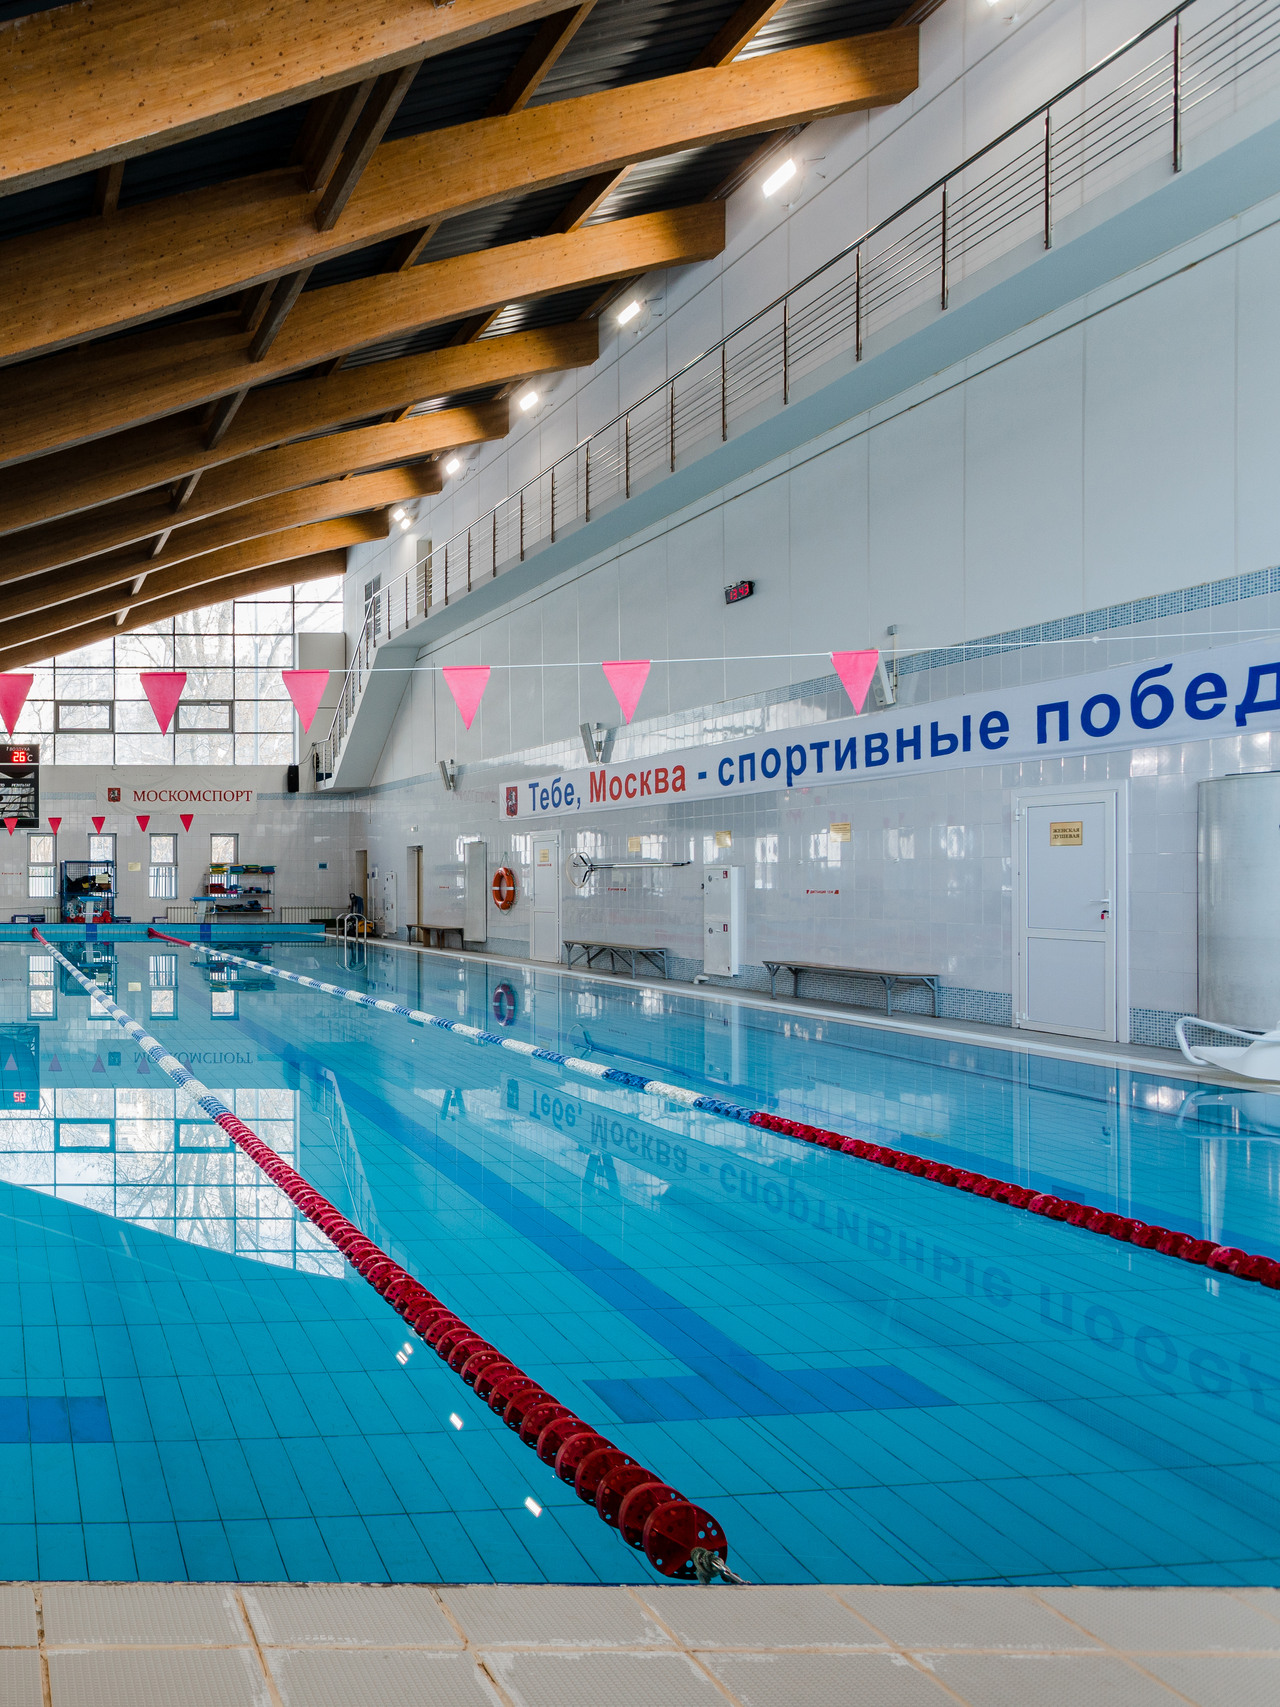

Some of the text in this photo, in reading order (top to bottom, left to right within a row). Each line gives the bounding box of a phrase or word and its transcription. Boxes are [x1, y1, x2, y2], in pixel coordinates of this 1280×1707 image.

[529, 777, 581, 810] Тебе,
[590, 765, 686, 803] Москва
[718, 710, 1010, 787] спортивные
[133, 790, 253, 802] МОСКОМСПОРТ
